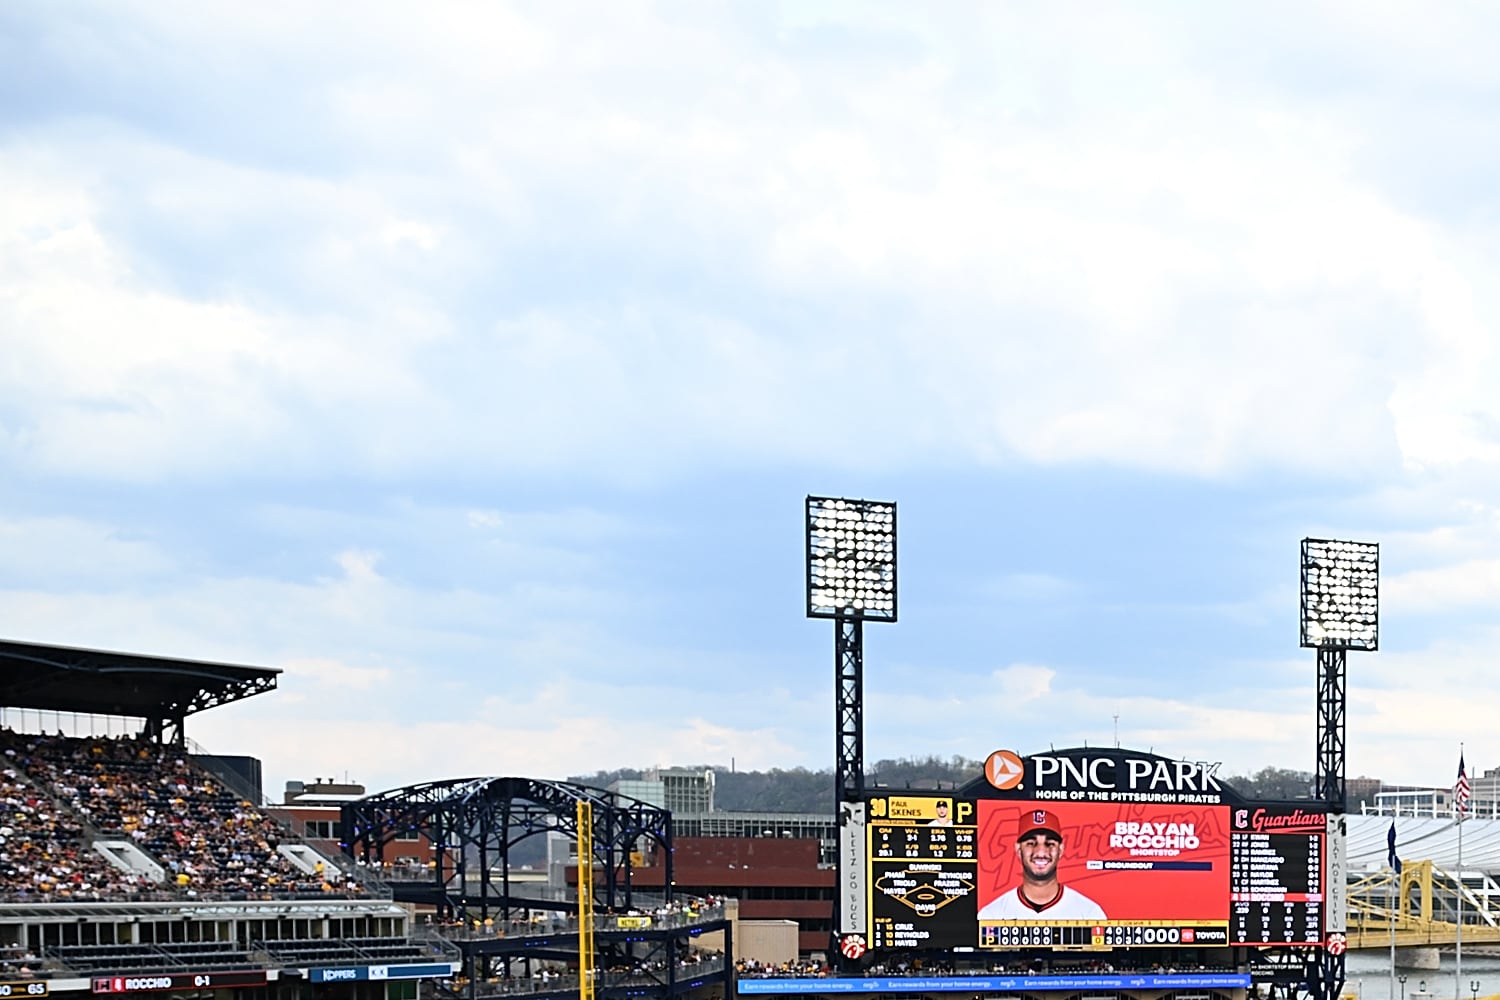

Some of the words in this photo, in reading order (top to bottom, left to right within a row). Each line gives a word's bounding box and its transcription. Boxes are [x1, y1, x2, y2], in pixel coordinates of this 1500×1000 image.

[1031, 756, 1116, 789] PNC
[1125, 759, 1222, 792] PARK
[1035, 790, 1069, 800] HOME
[1070, 790, 1086, 801] OF
[1087, 791, 1110, 802] THE
[1111, 792, 1177, 803] PITTSBURGH
[1178, 794, 1221, 804] PIRATES
[870, 798, 887, 817] 30
[891, 809, 922, 817] SKENES
[957, 802, 973, 824] P
[1235, 809, 1248, 829] C
[1252, 808, 1326, 833] Guardians
[1115, 821, 1195, 836] BRAYAN
[1110, 835, 1200, 849] ROCCHIO
[1130, 849, 1181, 857] SHORTSTOP
[1104, 862, 1155, 870] GROUNDOUT
[849, 871, 858, 890] GO
[884, 871, 906, 879] PHAM
[938, 872, 973, 880] REYNOLDS
[943, 888, 968, 896] VALDEZ
[1195, 931, 1226, 940] TOYOTA
[323, 968, 356, 981] KOPPERS
[125, 976, 172, 989] ROCCHIO
[194, 975, 211, 987] 0-1
[744, 982, 759, 991] Earn
[760, 982, 783, 991] rewards
[784, 982, 799, 991] from
[800, 982, 814, 991] your
[814, 982, 831, 991] home
[888, 980, 900, 989] Earn
[901, 980, 923, 989] rewards
[923, 980, 937, 989] from
[938, 980, 950, 989] your
[951, 980, 968, 989] home
[1024, 978, 1037, 988] Earn
[1037, 978, 1060, 988] rewards
[1060, 978, 1074, 988] from
[1074, 978, 1086, 988] your
[1087, 978, 1102, 988] home
[1154, 977, 1166, 986] Earn
[1167, 977, 1188, 986] rewards
[1189, 977, 1202, 986] from
[1202, 977, 1213, 986] your
[1214, 977, 1229, 986] home
[27, 983, 45, 995] 65
